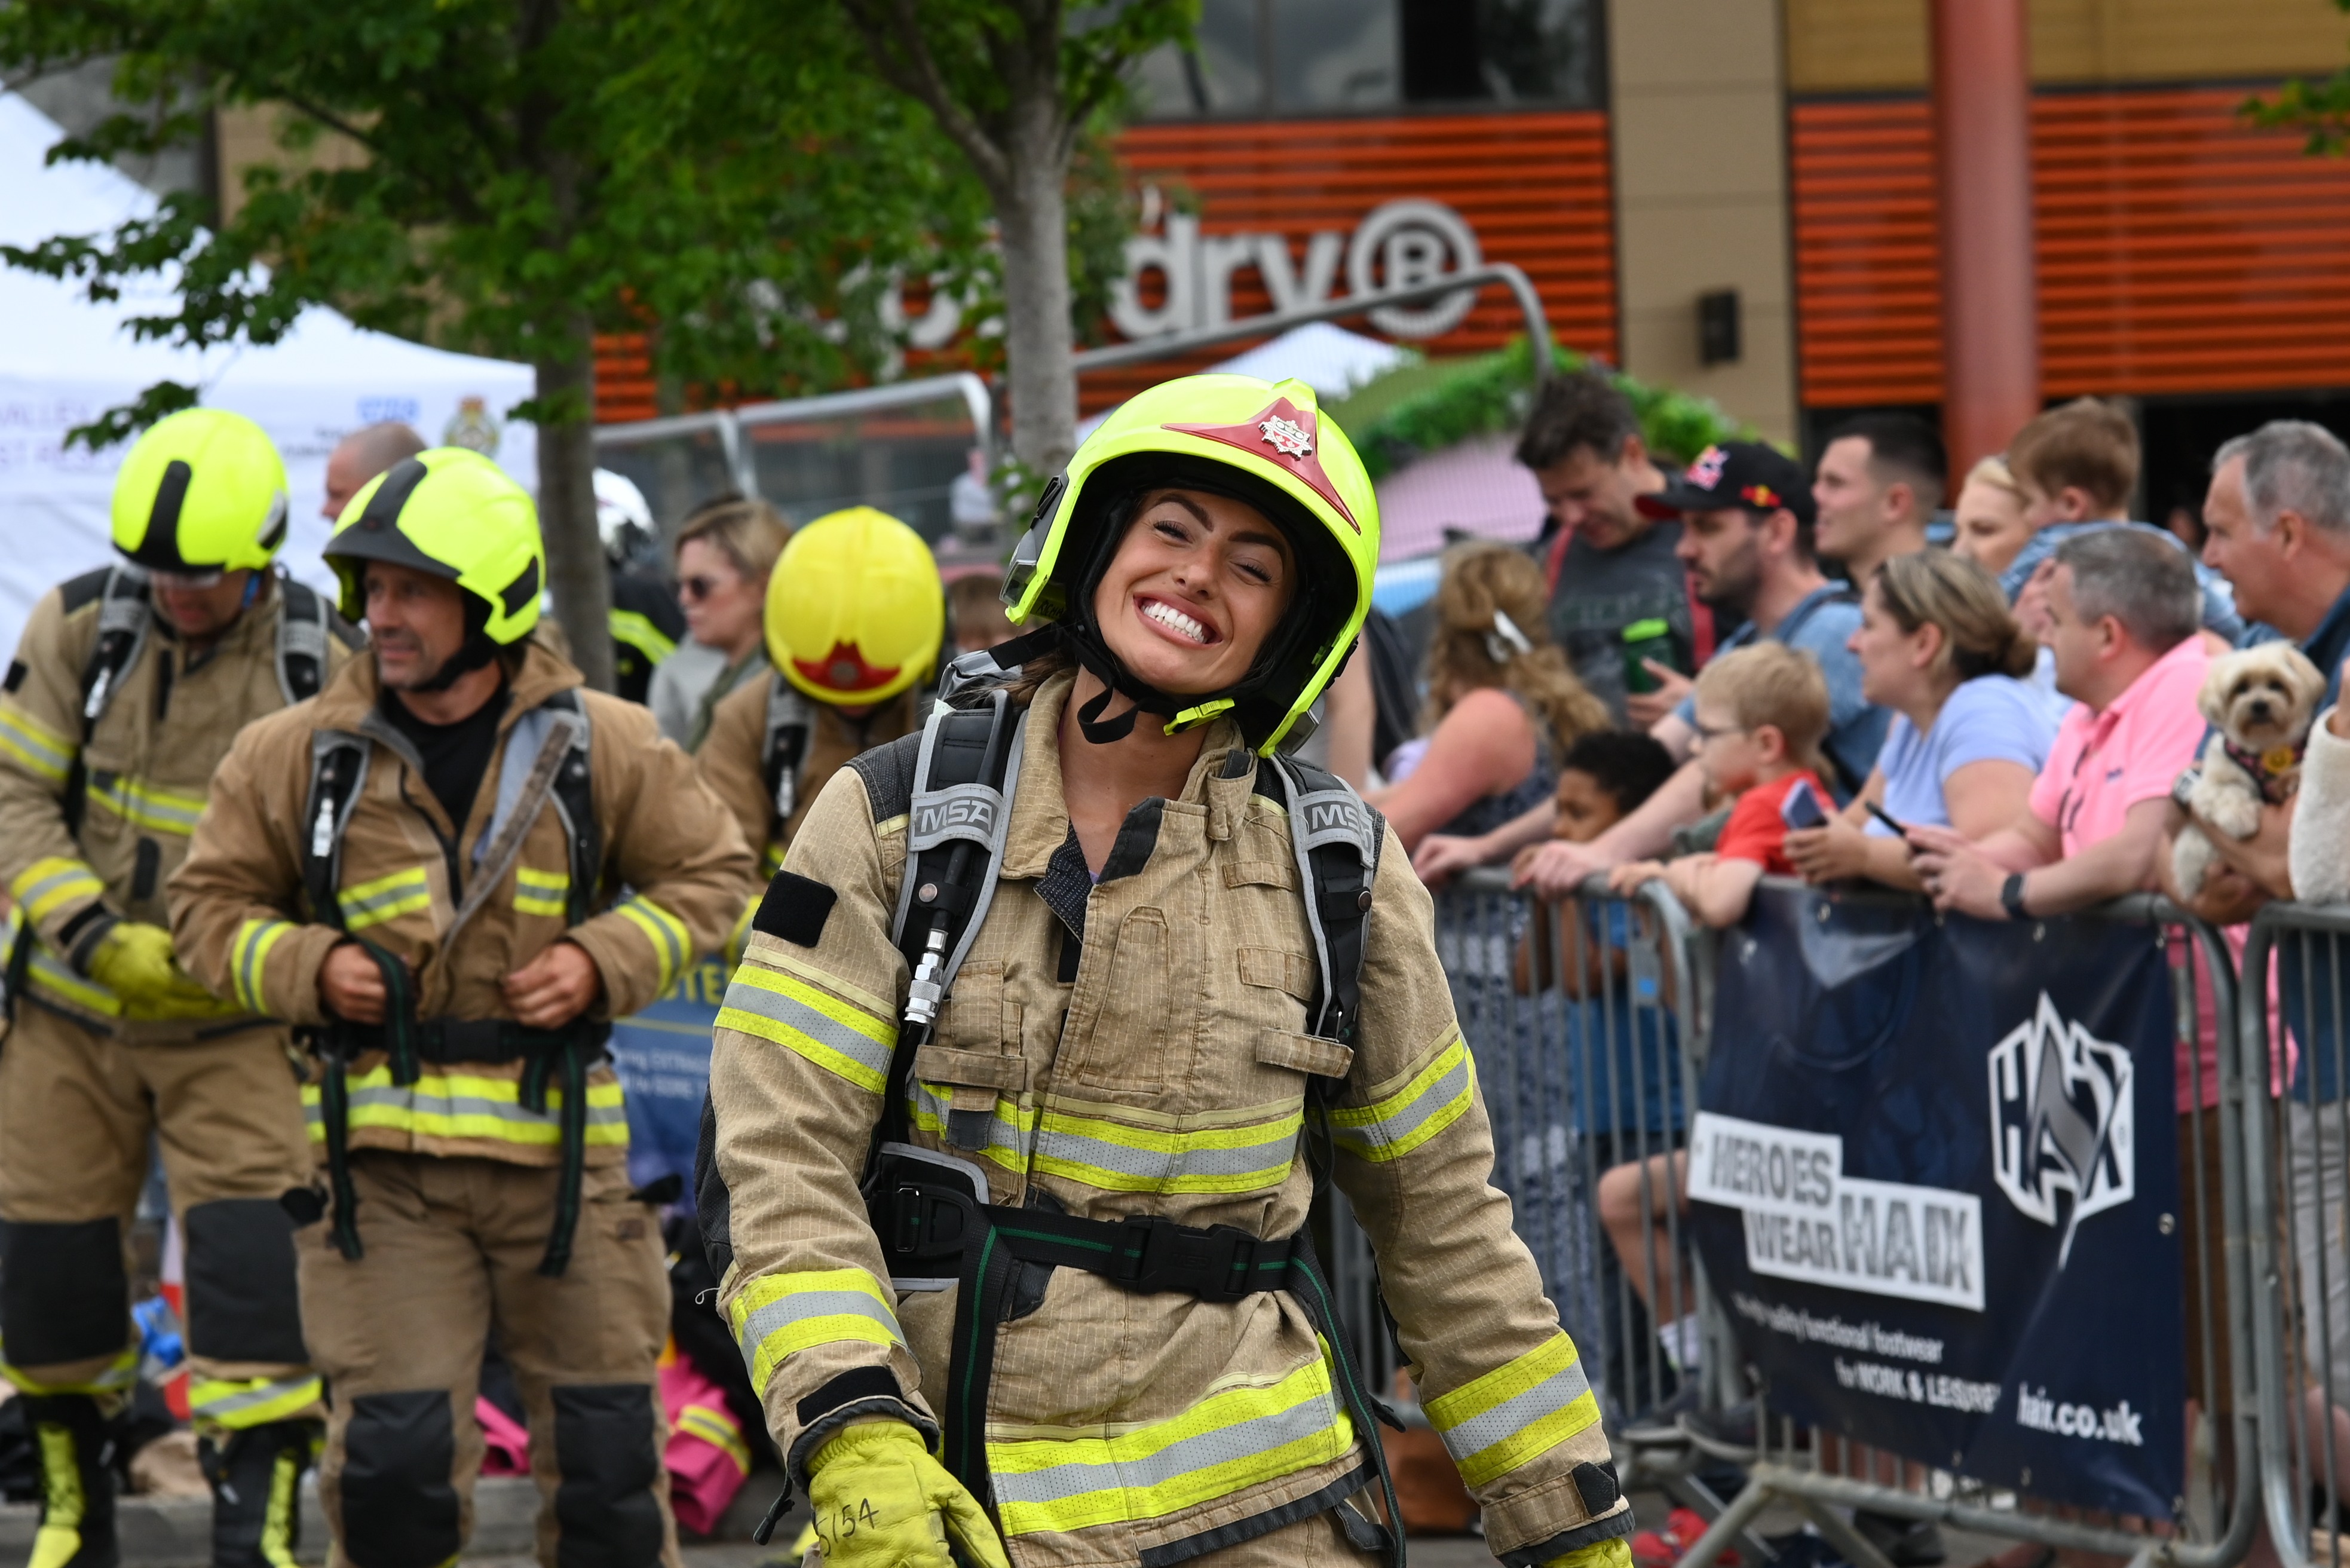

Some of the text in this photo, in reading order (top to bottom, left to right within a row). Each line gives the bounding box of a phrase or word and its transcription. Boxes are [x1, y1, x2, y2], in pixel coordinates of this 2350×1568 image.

[920, 800, 994, 833] MSA
[1312, 804, 1373, 849] MSA
[1709, 1133, 1833, 1207] HEROES
[1750, 1195, 1971, 1293] WEAR HAIX
[1905, 1370, 1925, 1402] &
